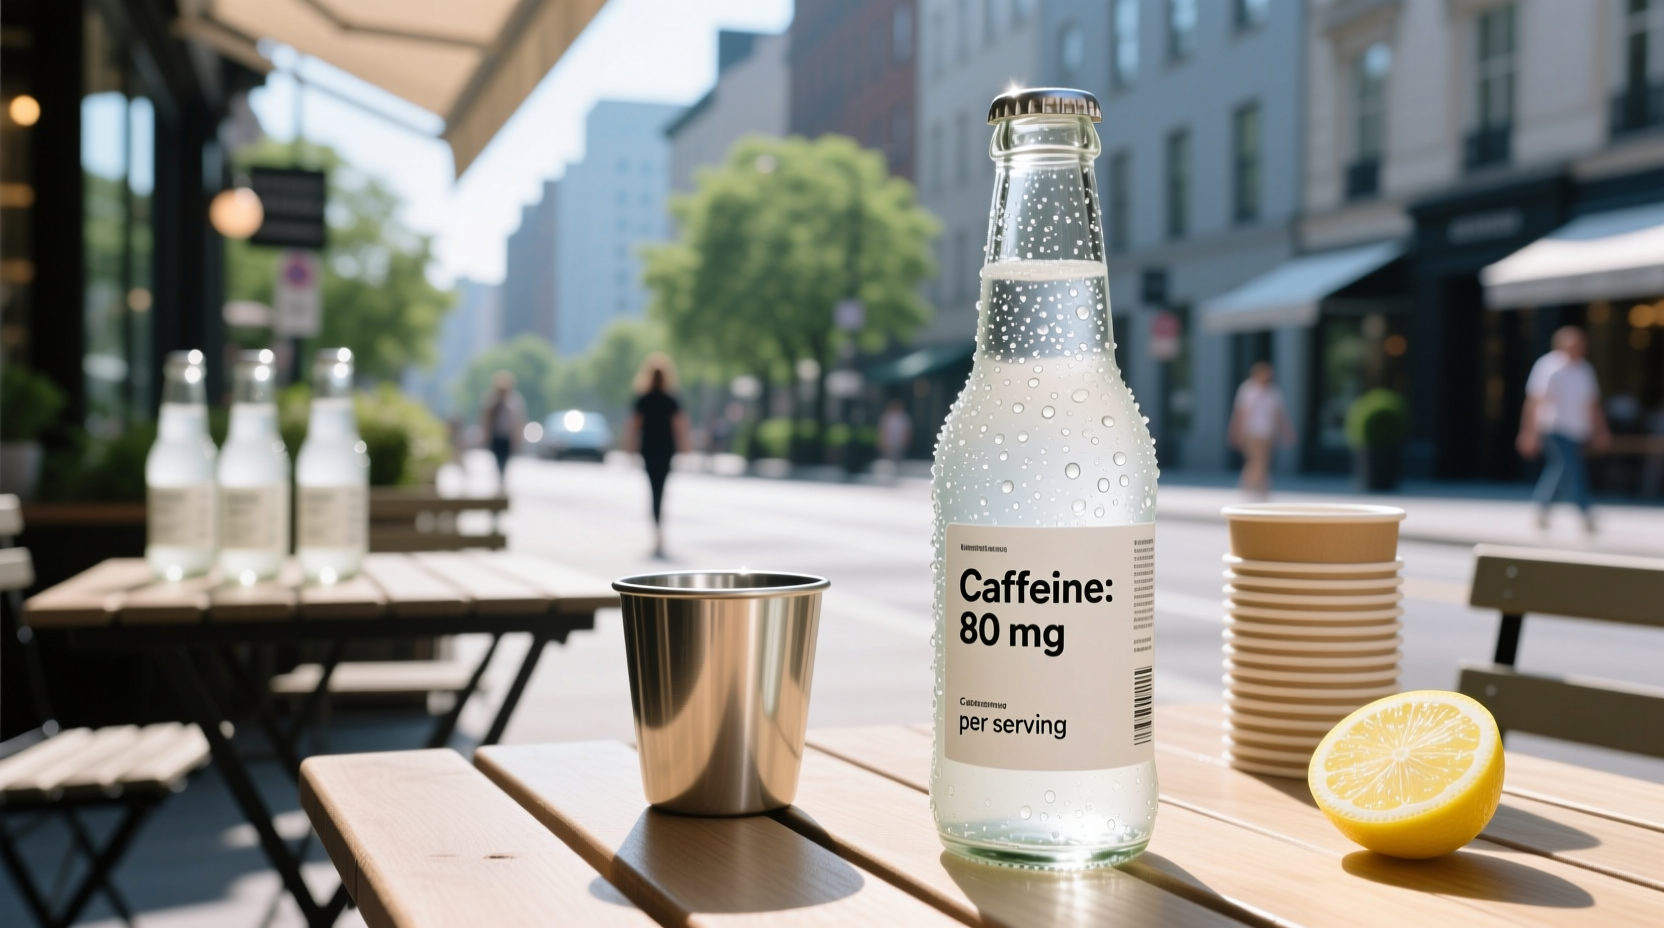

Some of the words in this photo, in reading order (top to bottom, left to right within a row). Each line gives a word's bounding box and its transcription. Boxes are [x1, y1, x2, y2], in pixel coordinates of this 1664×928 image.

[959, 567, 1113, 605] Caffeine:
[959, 610, 1001, 647] 80
[1009, 623, 1065, 658] mg
[959, 714, 989, 736] per
[992, 713, 1067, 740] serving
